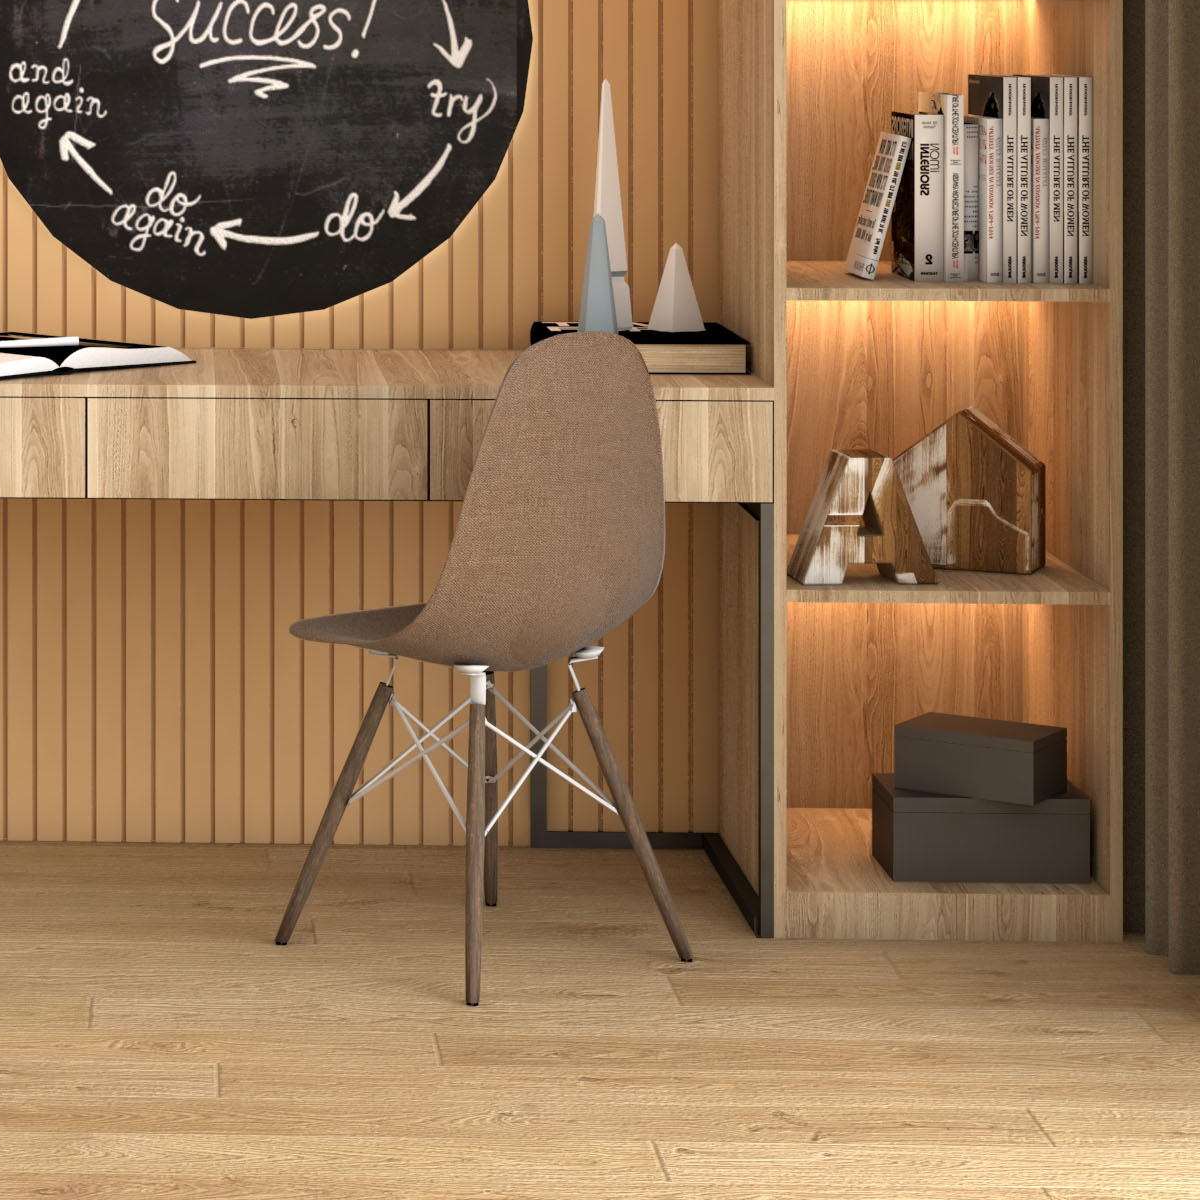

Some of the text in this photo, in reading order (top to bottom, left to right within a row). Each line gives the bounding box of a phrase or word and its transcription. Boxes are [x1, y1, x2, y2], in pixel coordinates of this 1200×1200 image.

[8, 58, 74, 87] and
[10, 88, 108, 129] again
[427, 77, 499, 145] try
[144, 170, 202, 218] do
[323, 192, 386, 243] do
[110, 201, 207, 257] again
